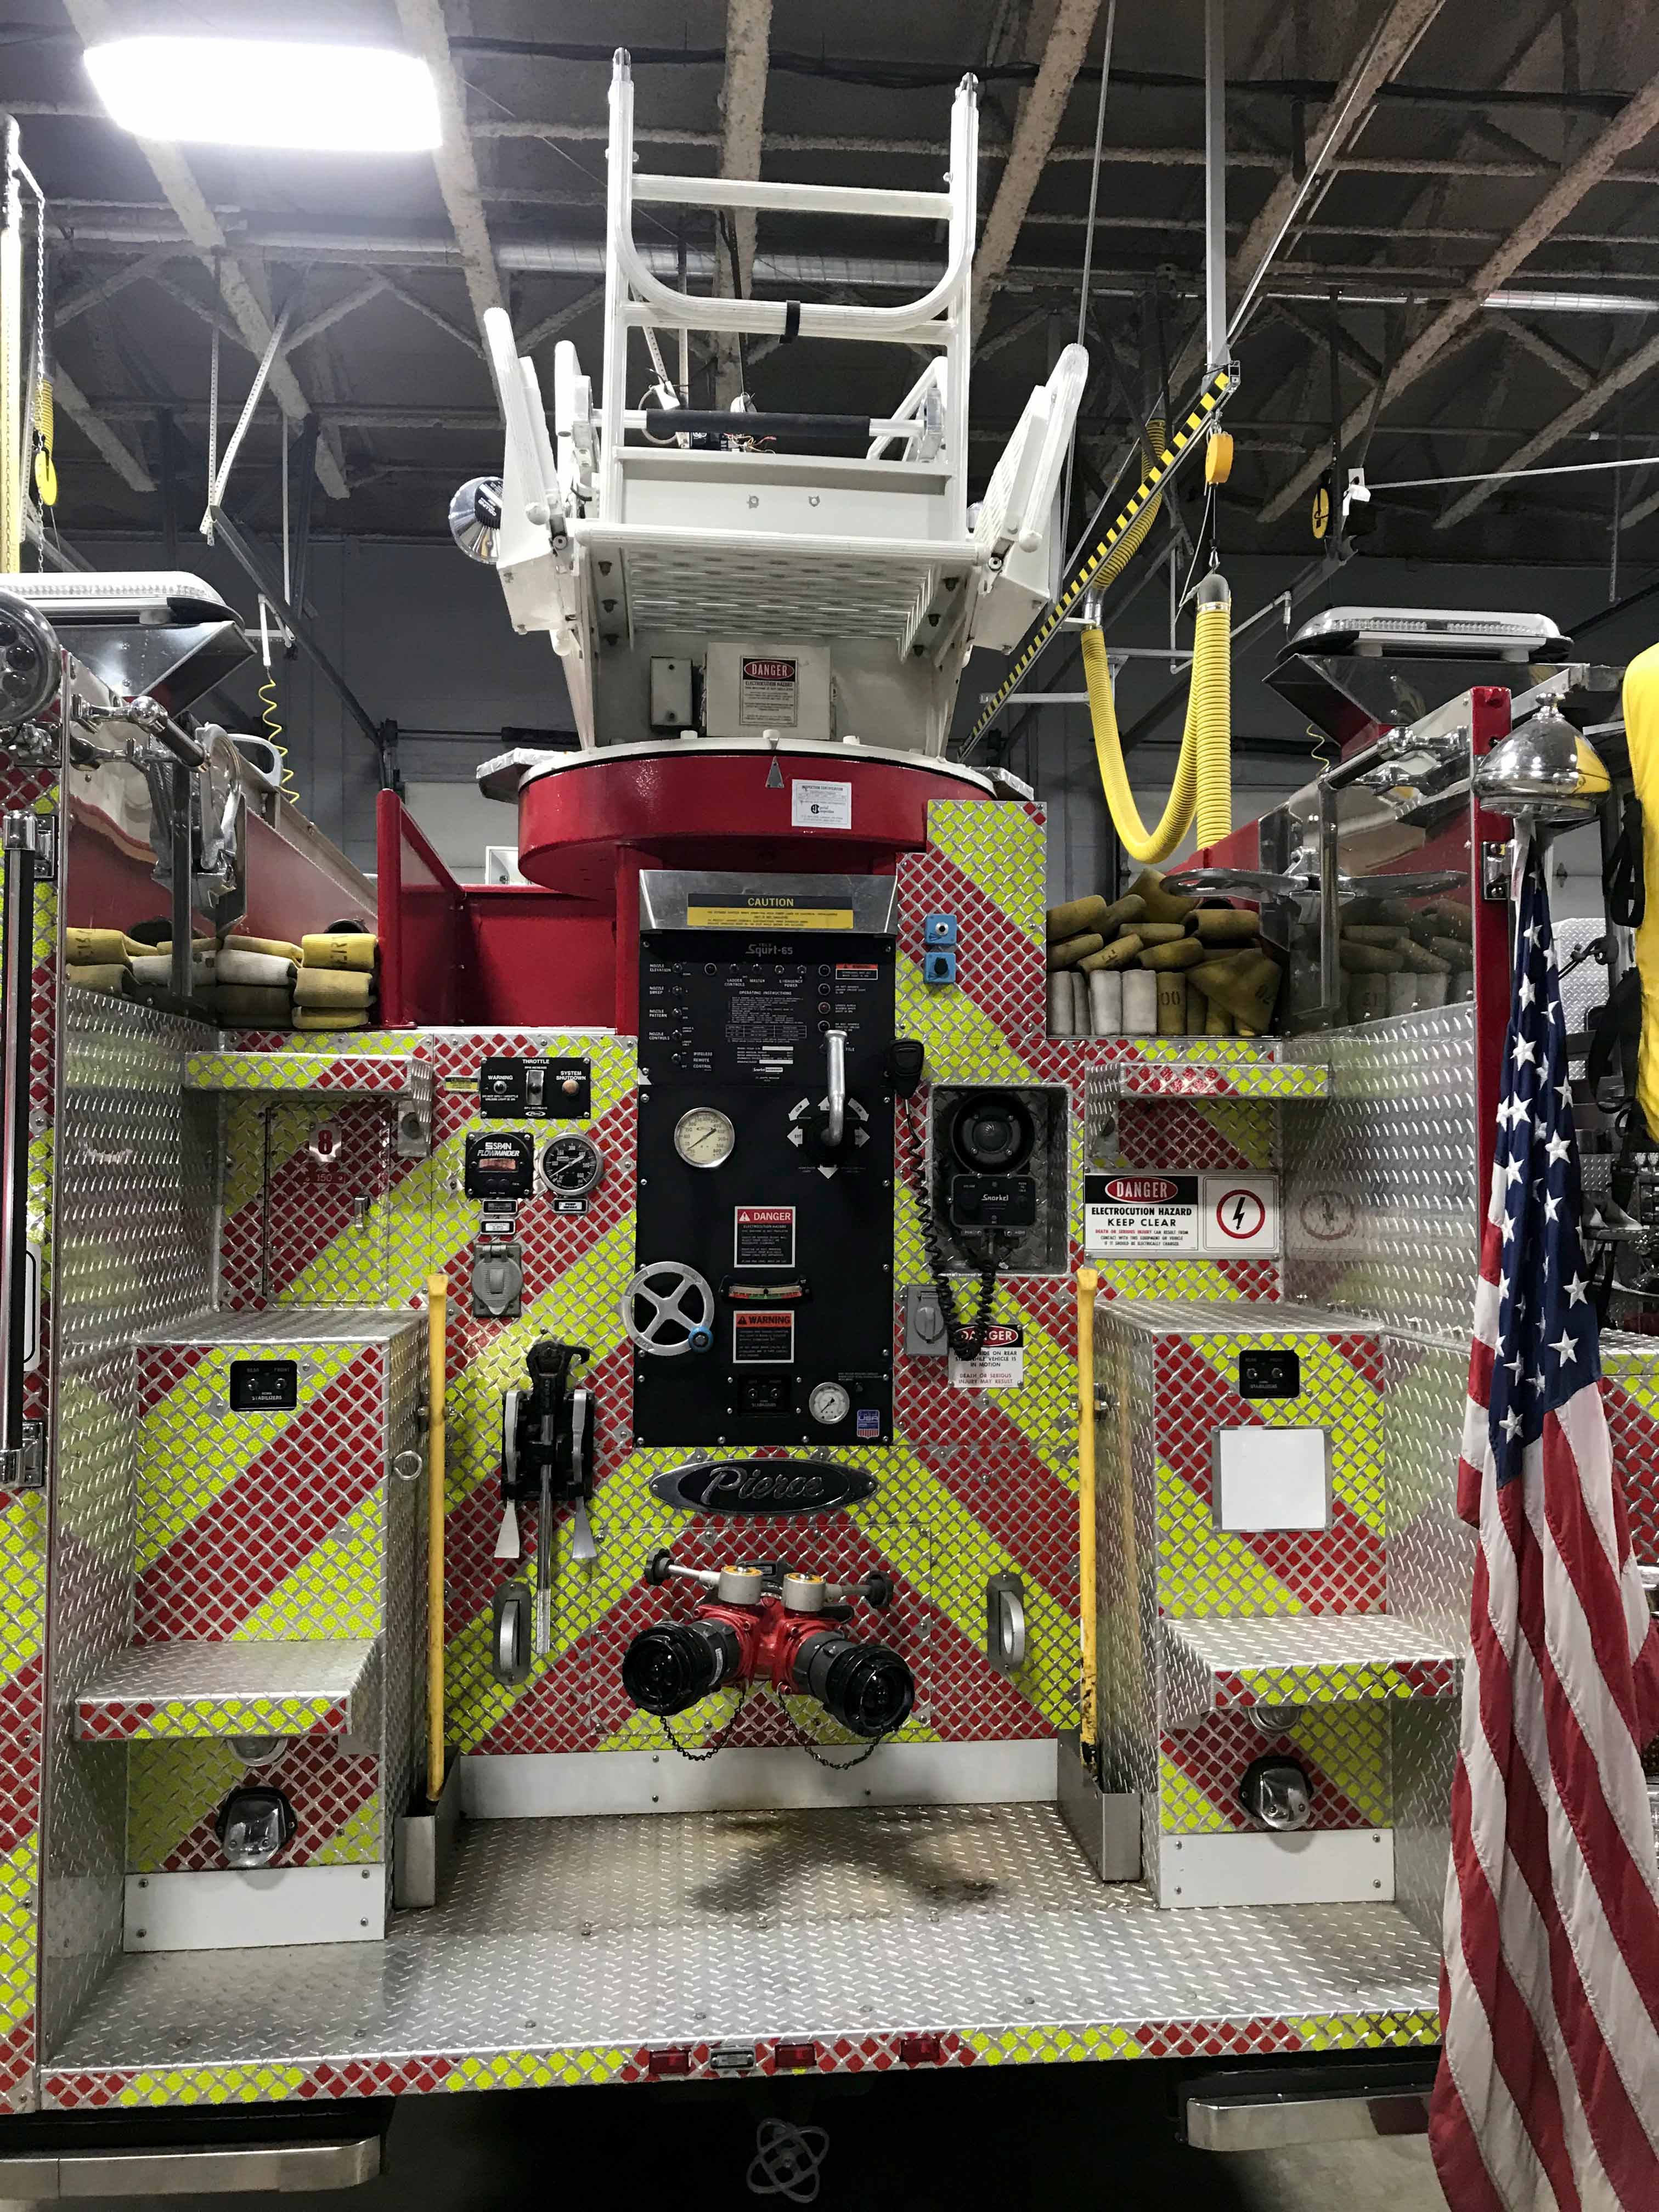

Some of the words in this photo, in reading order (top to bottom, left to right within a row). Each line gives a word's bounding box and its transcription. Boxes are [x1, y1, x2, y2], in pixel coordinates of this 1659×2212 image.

[752, 664, 787, 676] DANGER
[748, 898, 794, 907] CAUTION
[745, 944, 793, 957] Squrt-65
[318, 1130, 332, 1155] 8
[1116, 1181, 1167, 1198] DANGER
[754, 1212, 791, 1221] DANGER
[1091, 1207, 1155, 1216] ELECTROCUTION
[1158, 1207, 1192, 1216] HAZARD
[1108, 1218, 1135, 1227] KEEP
[1141, 1218, 1177, 1227] CLEAR
[748, 1316, 791, 1324] WARNING
[961, 1330, 1012, 1341] DAGER
[700, 1466, 824, 1505] Pierce
